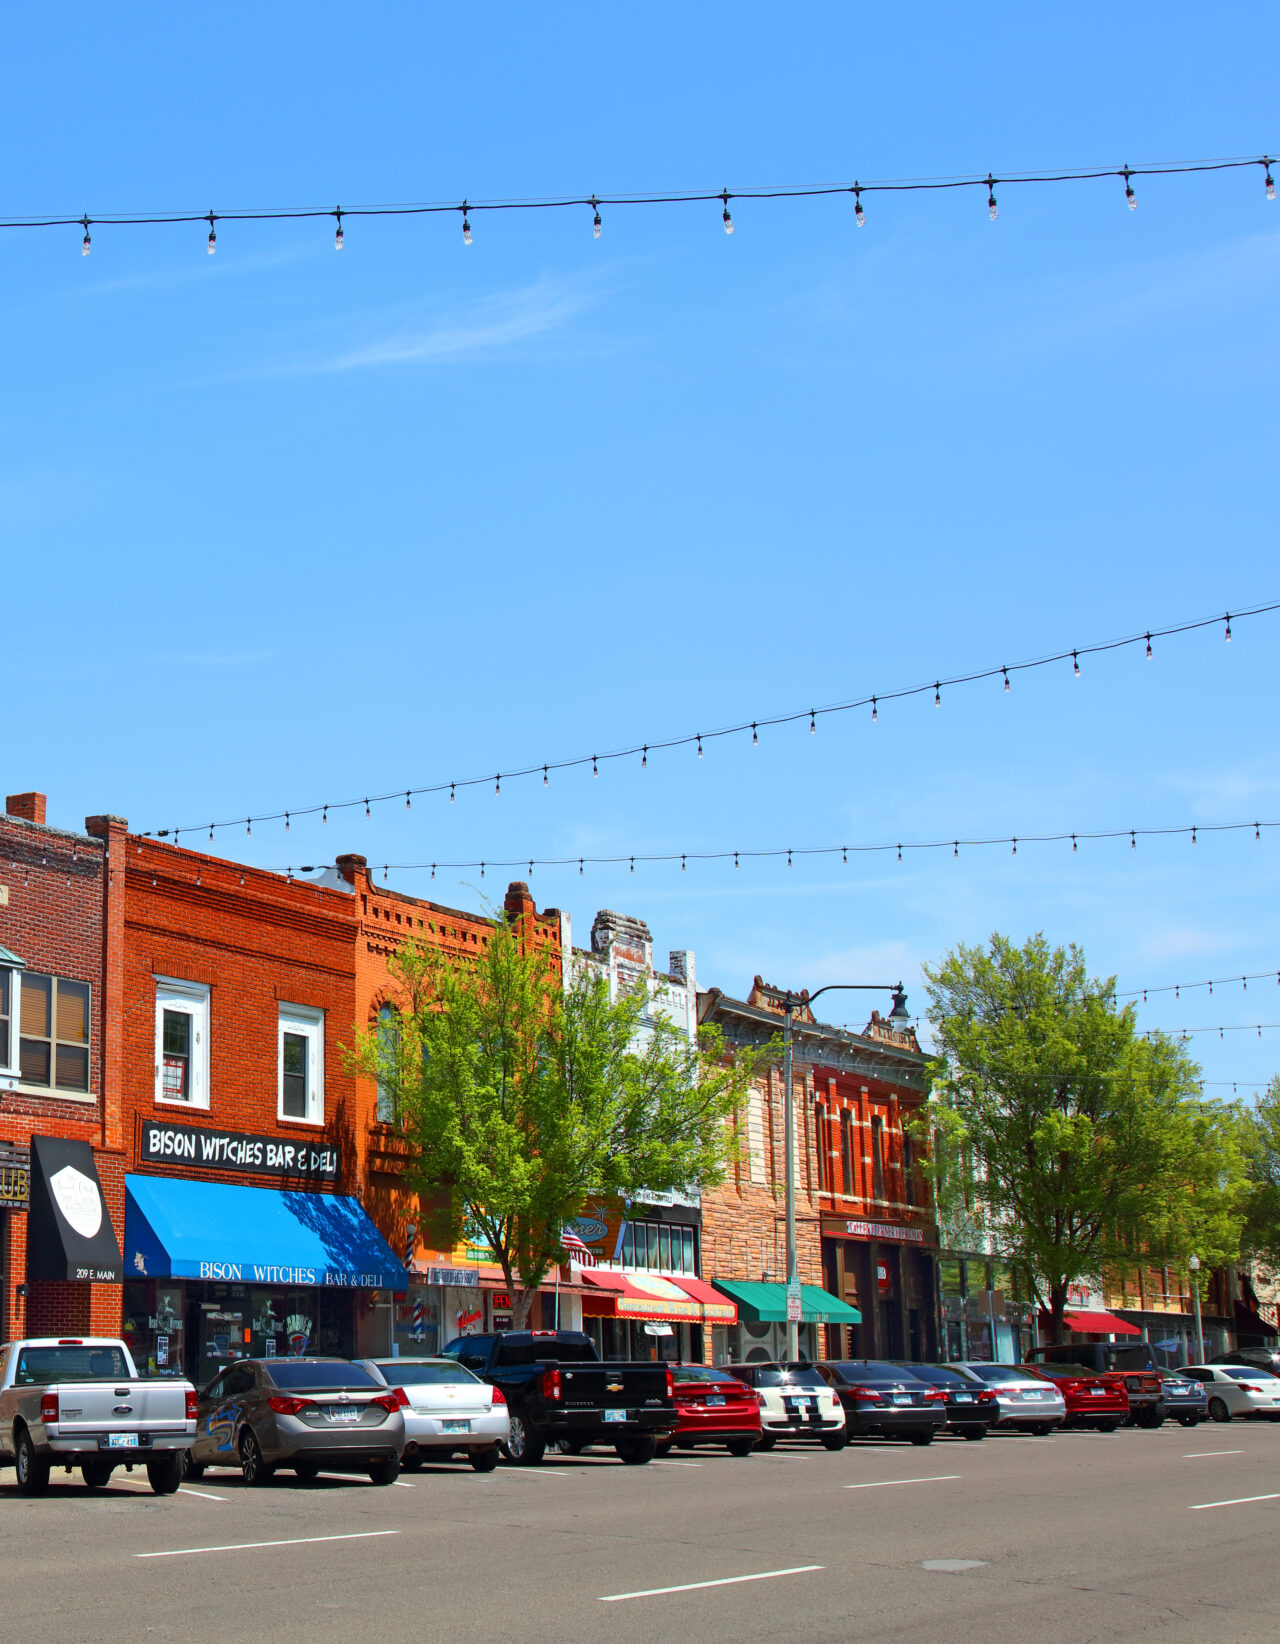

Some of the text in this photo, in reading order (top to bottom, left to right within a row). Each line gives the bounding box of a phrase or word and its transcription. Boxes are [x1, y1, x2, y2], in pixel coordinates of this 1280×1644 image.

[149, 1129, 337, 1173] BISON WITCHES BAR & DELI
[76, 1268, 88, 1279] 209
[96, 1270, 115, 1280] MAIN
[200, 1261, 383, 1287] BISON WITCHES BAR & DELI
[618, 1298, 665, 1314] Restaurant
